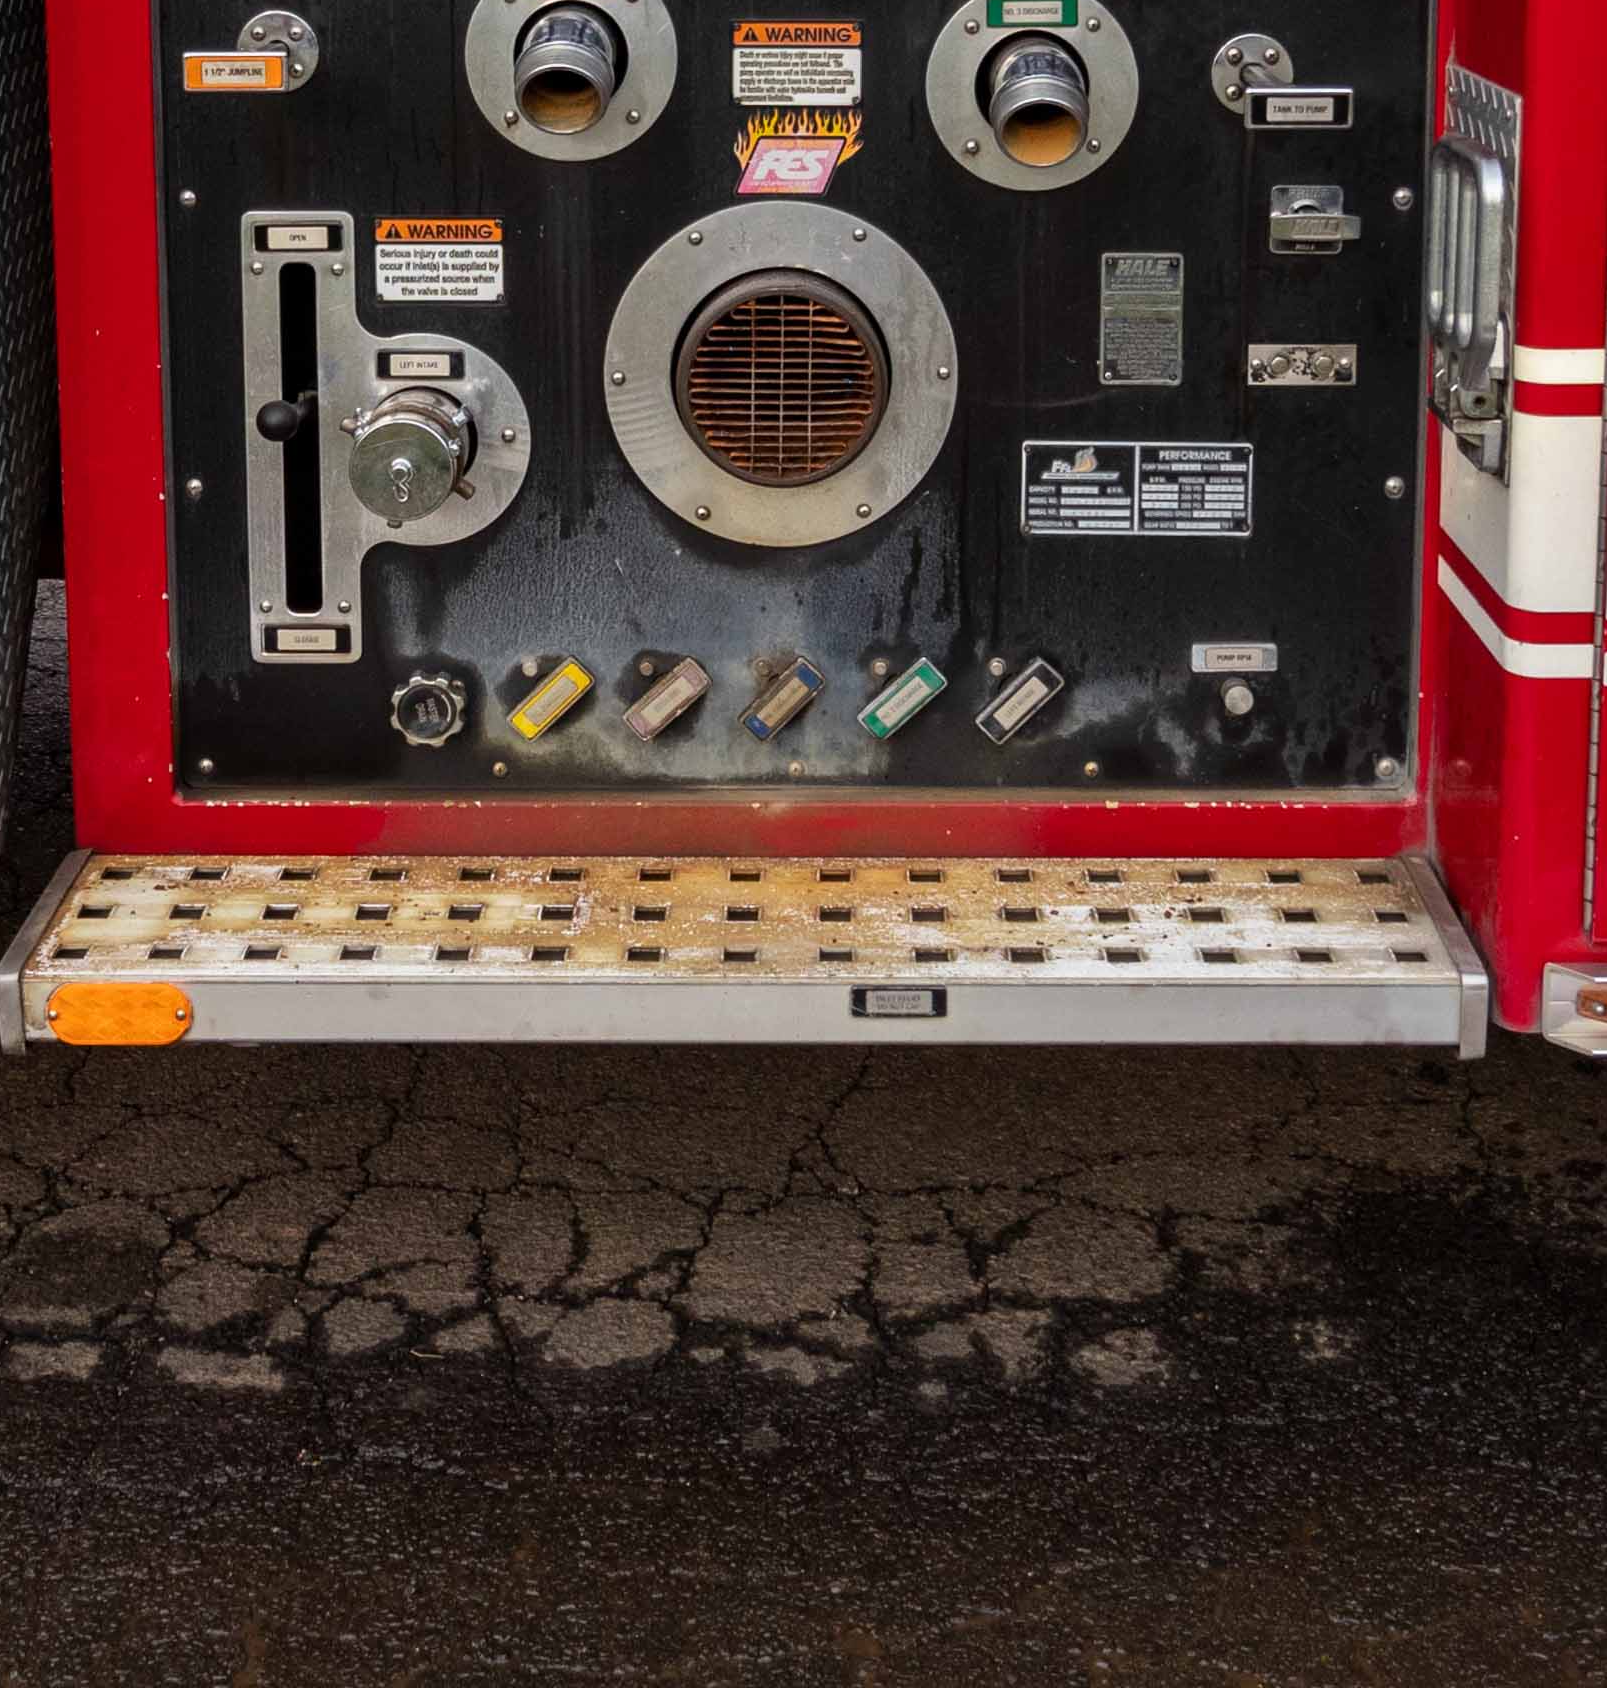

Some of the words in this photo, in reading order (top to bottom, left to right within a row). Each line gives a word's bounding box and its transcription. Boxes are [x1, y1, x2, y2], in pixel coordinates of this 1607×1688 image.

[765, 27, 851, 42] WARNING
[228, 68, 263, 76] JUMPLINE
[407, 224, 493, 239] WARNING
[380, 249, 411, 258] Serious
[413, 249, 436, 259] injury
[449, 249, 473, 258] death
[475, 249, 498, 258] could
[405, 262, 411, 270] if
[413, 262, 440, 272] inlet(s)
[442, 262, 449, 270] is
[452, 262, 487, 272] supplied
[489, 262, 499, 272] by
[1115, 259, 1170, 276] HALE
[392, 275, 440, 285] pressurized
[472, 275, 495, 283] when
[401, 287, 415, 296] the
[417, 287, 438, 296] valve
[441, 287, 447, 296] is
[450, 287, 477, 296] closed
[1158, 450, 1232, 461] PERFORMANCE
